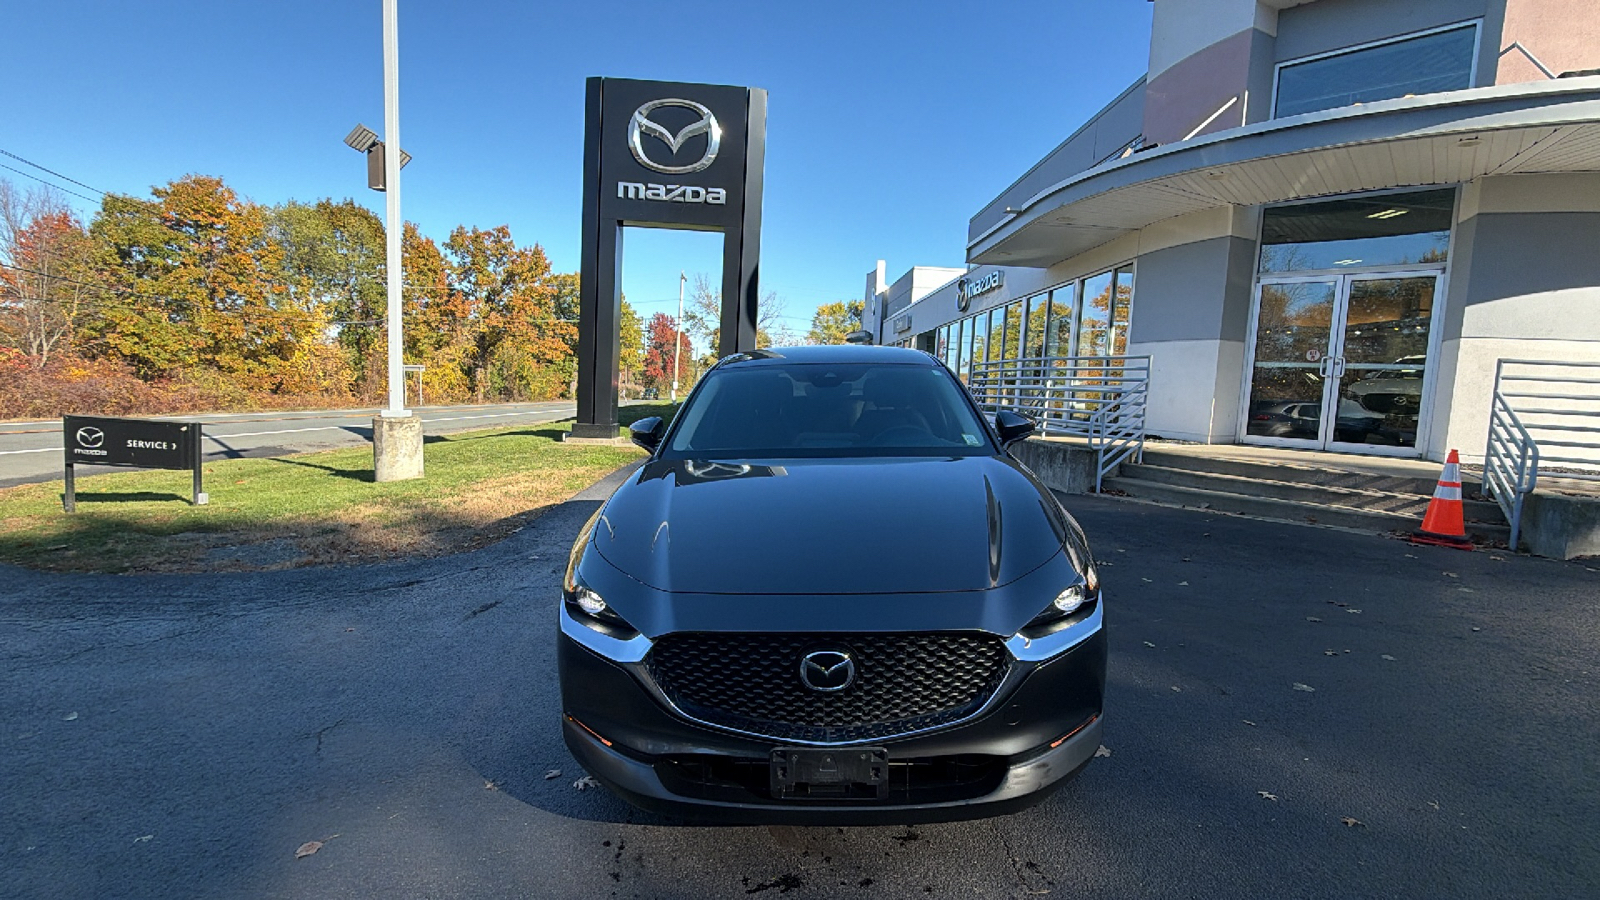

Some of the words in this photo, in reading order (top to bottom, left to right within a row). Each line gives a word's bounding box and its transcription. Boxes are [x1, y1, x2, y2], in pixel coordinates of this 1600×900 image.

[617, 181, 727, 205] mazda
[968, 270, 1000, 298] mazda
[126, 439, 168, 450] SERVICE
